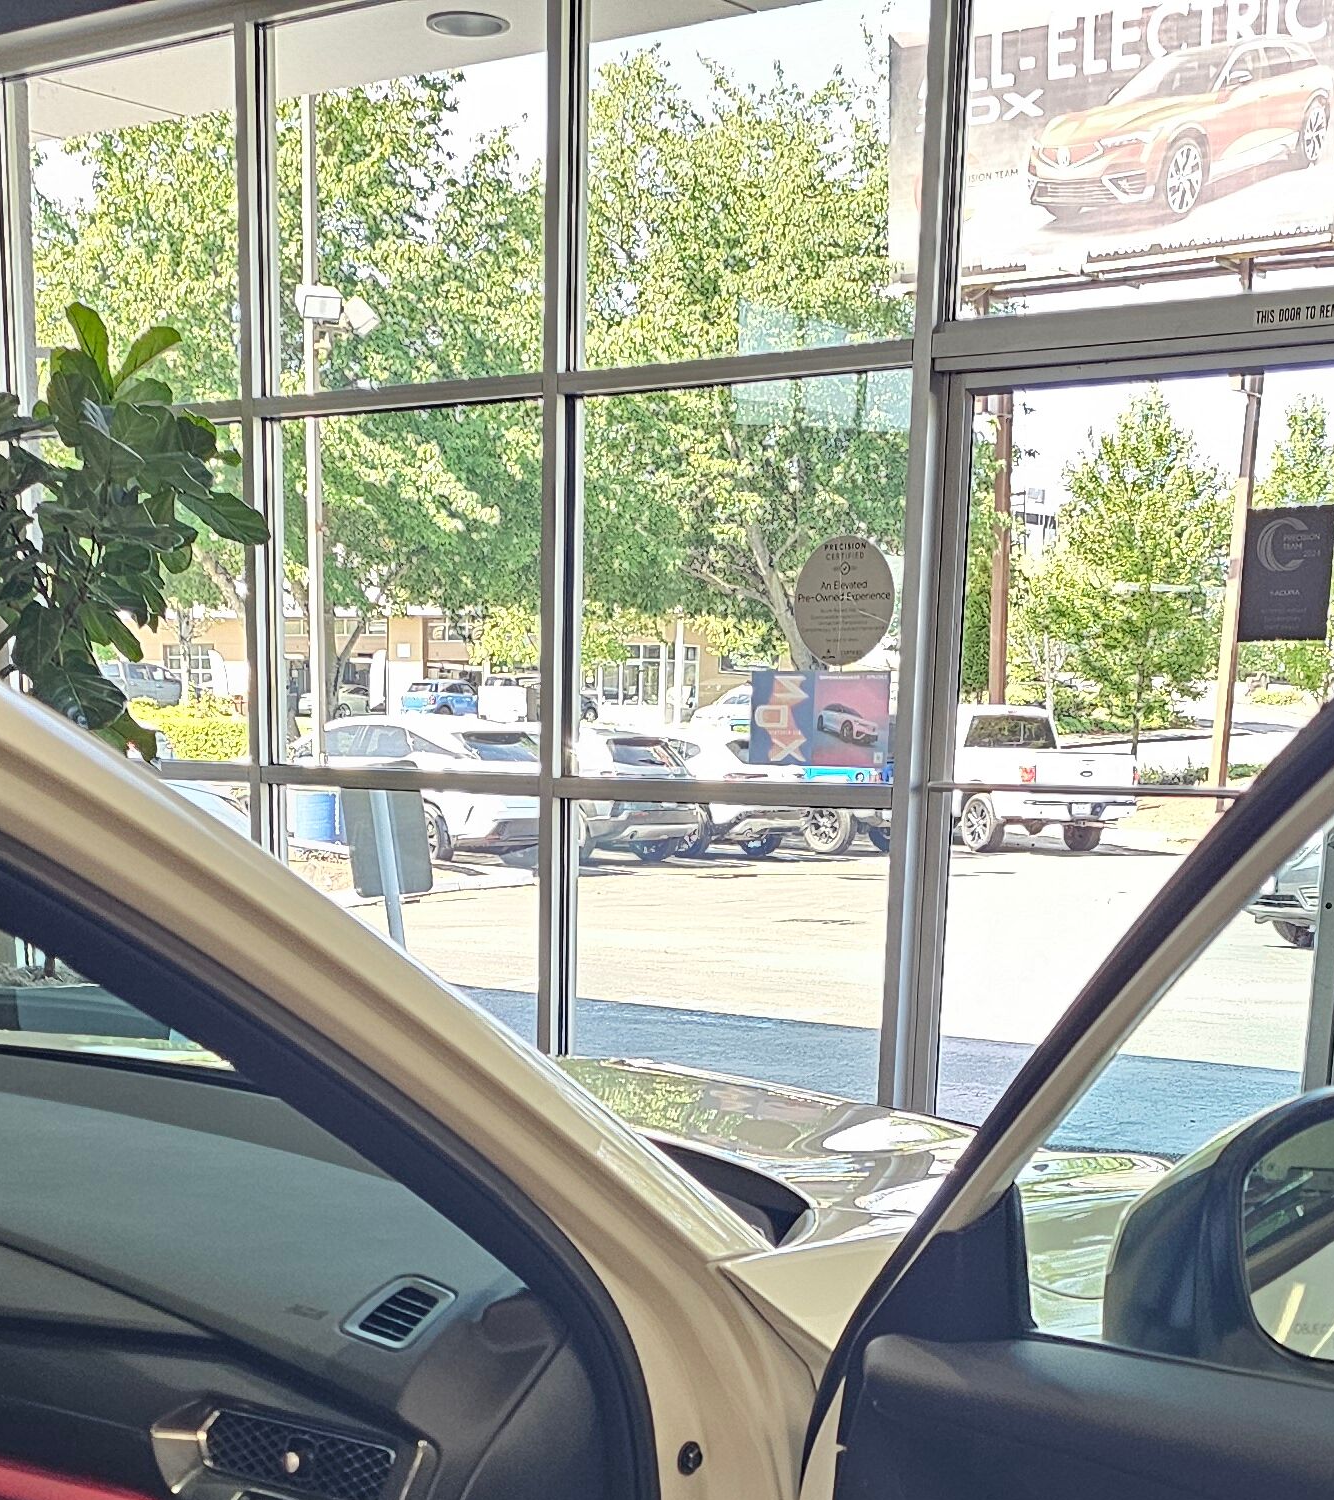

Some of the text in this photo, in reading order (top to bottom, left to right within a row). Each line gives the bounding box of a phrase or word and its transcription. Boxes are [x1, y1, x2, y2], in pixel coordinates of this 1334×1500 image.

[917, 0, 1328, 98] LL-ELECTRIC
[1256, 309, 1275, 325] THIS
[1278, 306, 1302, 323] DOOR
[1305, 305, 1316, 320] TO
[824, 542, 867, 551] PRECISION
[825, 551, 865, 561] CERTIFIED
[820, 580, 868, 590] An Elevated
[797, 591, 891, 603] Pre-Owned Experience
